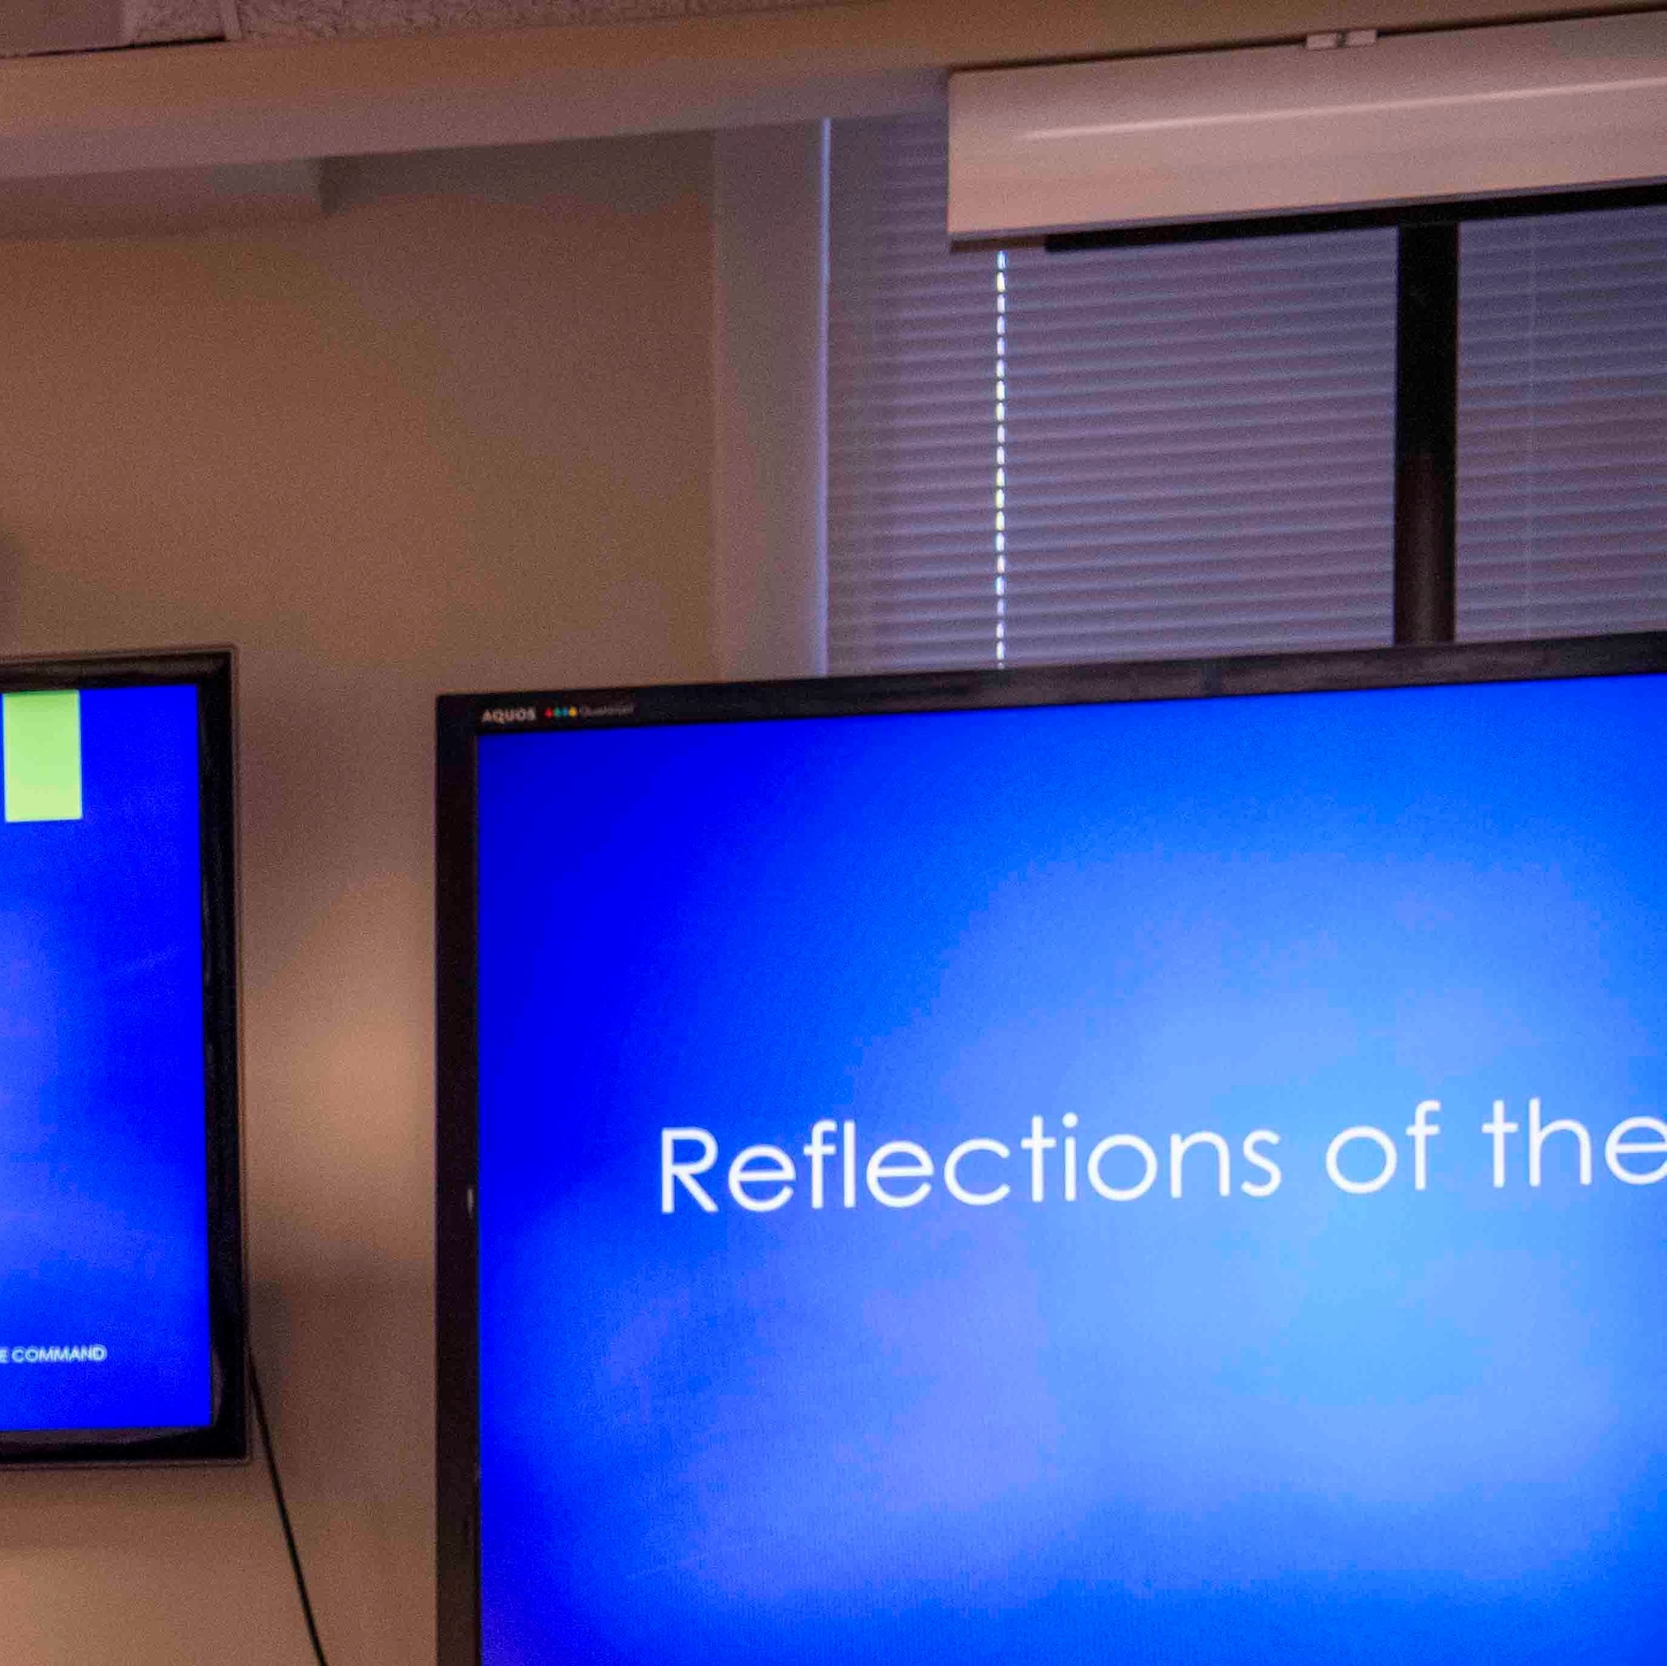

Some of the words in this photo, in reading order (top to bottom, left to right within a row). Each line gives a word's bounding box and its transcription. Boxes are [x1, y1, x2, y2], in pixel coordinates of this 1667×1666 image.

[481, 707, 537, 724] AQUOS
[661, 1112, 1282, 1212] Reflections
[1326, 1099, 1441, 1194] of
[1481, 1097, 1667, 1186] the
[11, 1344, 108, 1363] COMMAND
